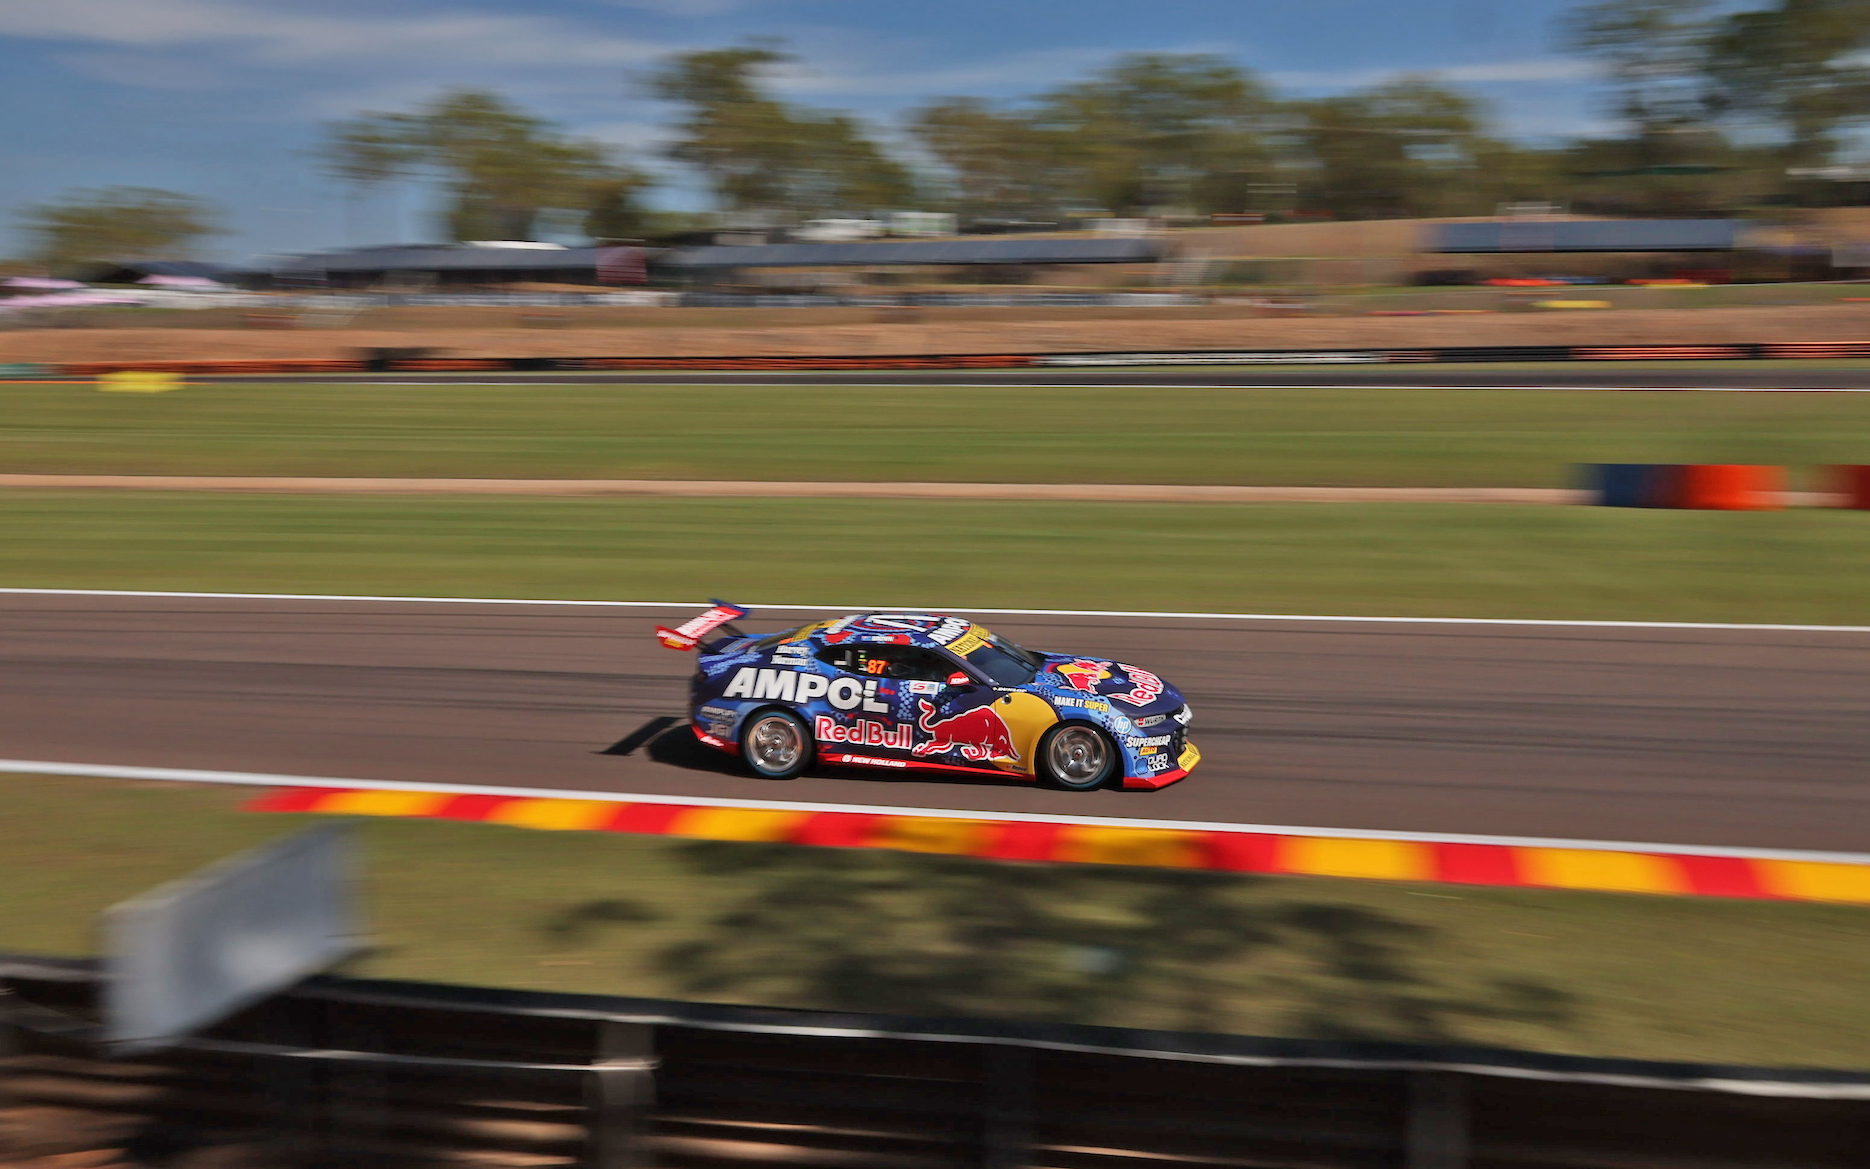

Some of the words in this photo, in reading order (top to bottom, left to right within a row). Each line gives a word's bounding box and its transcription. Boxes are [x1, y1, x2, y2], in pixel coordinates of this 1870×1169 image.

[867, 659, 887, 675] 87
[722, 667, 889, 714] AMPOL
[1054, 696, 1075, 707] MAKE
[1075, 698, 1084, 708] IT
[1084, 700, 1109, 713] SUPER
[1126, 735, 1171, 748] SUPERCHEAP
[851, 756, 870, 764] NEW
[870, 758, 906, 768] HOLLAND
[1147, 753, 1168, 765] QUAD
[1147, 762, 1170, 772] LOCK
